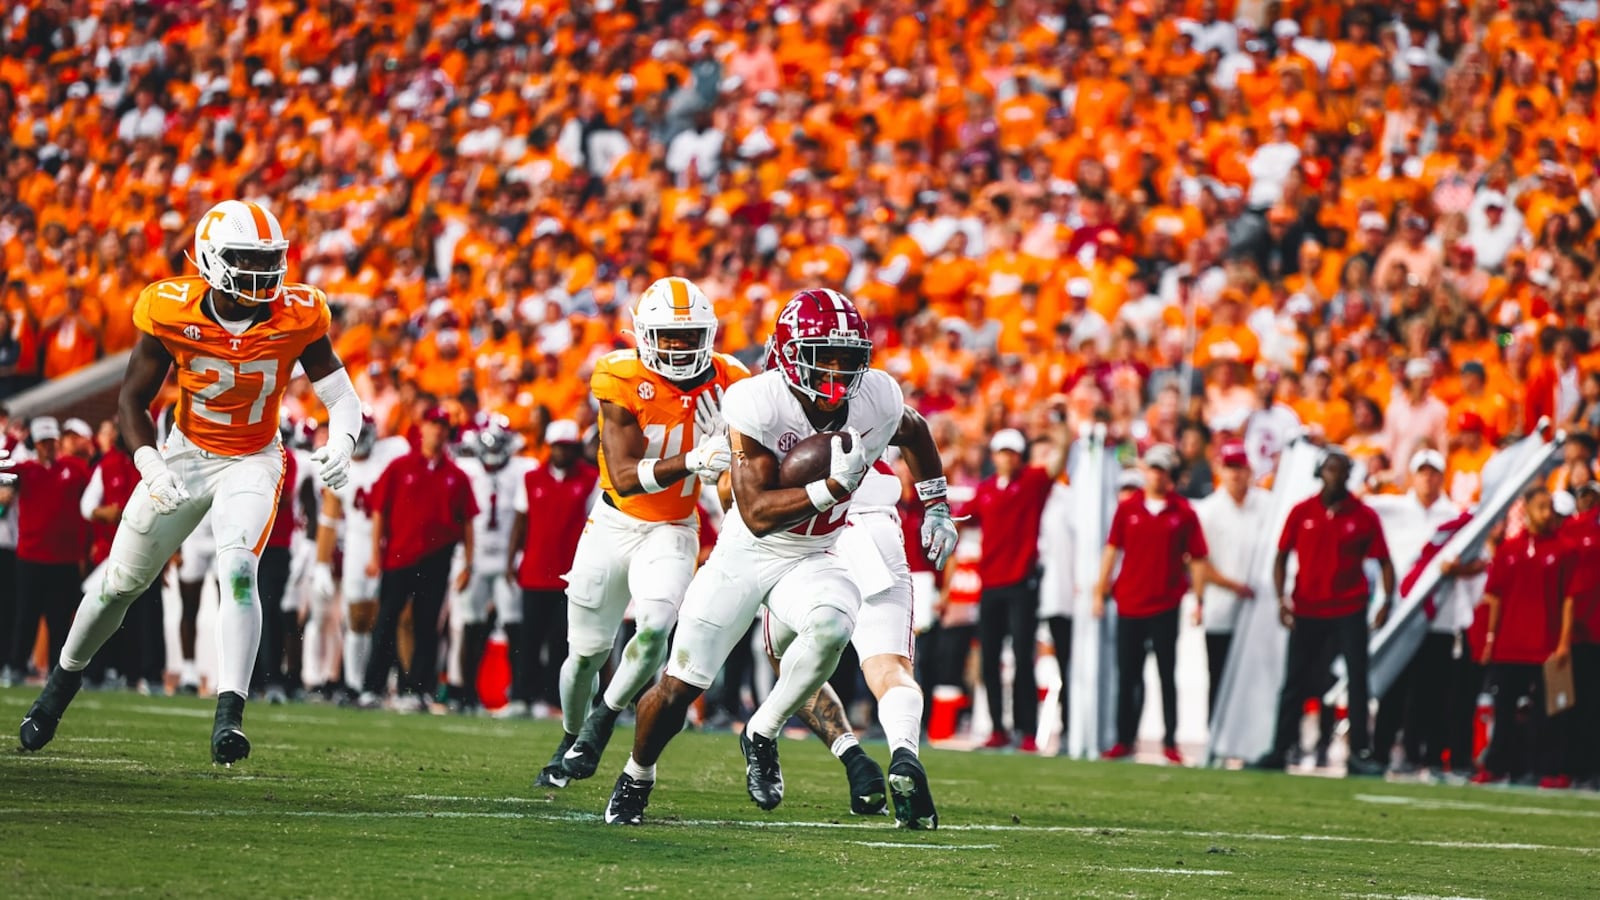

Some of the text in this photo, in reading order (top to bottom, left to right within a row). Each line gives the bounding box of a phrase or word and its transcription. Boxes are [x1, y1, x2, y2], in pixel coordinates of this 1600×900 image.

[200, 211, 226, 241] T
[157, 281, 190, 303] 27
[183, 325, 201, 341] SEC
[229, 339, 242, 350] T
[189, 356, 279, 425] 27
[638, 381, 655, 400] SEC
[680, 395, 692, 408] T
[780, 433, 797, 451] SEC
